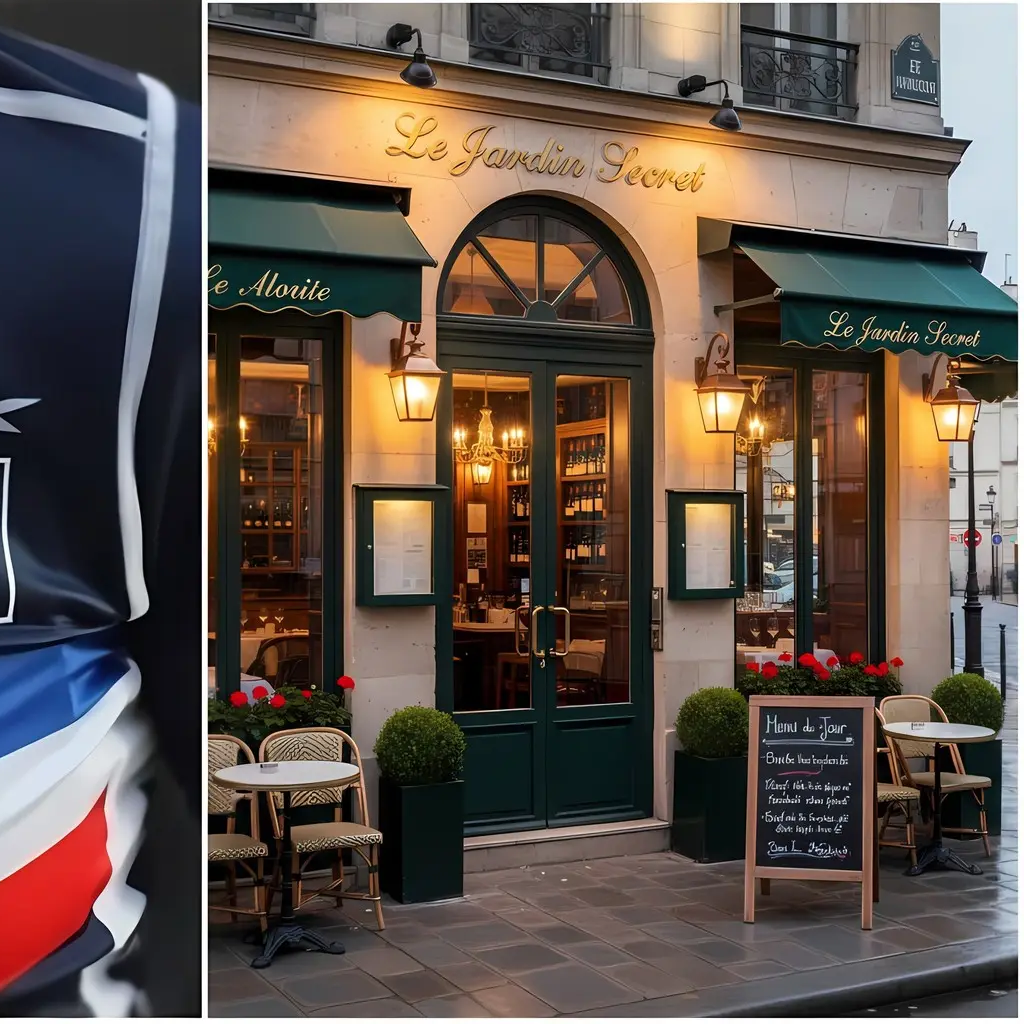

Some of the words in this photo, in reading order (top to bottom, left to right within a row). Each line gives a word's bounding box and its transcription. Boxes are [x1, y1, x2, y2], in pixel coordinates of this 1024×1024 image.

[384, 111, 449, 162] Le
[448, 124, 587, 179] Jardin
[595, 139, 708, 194] Secret
[823, 310, 855, 338] Le
[855, 315, 921, 347] Jardin
[924, 319, 981, 348] Secret
